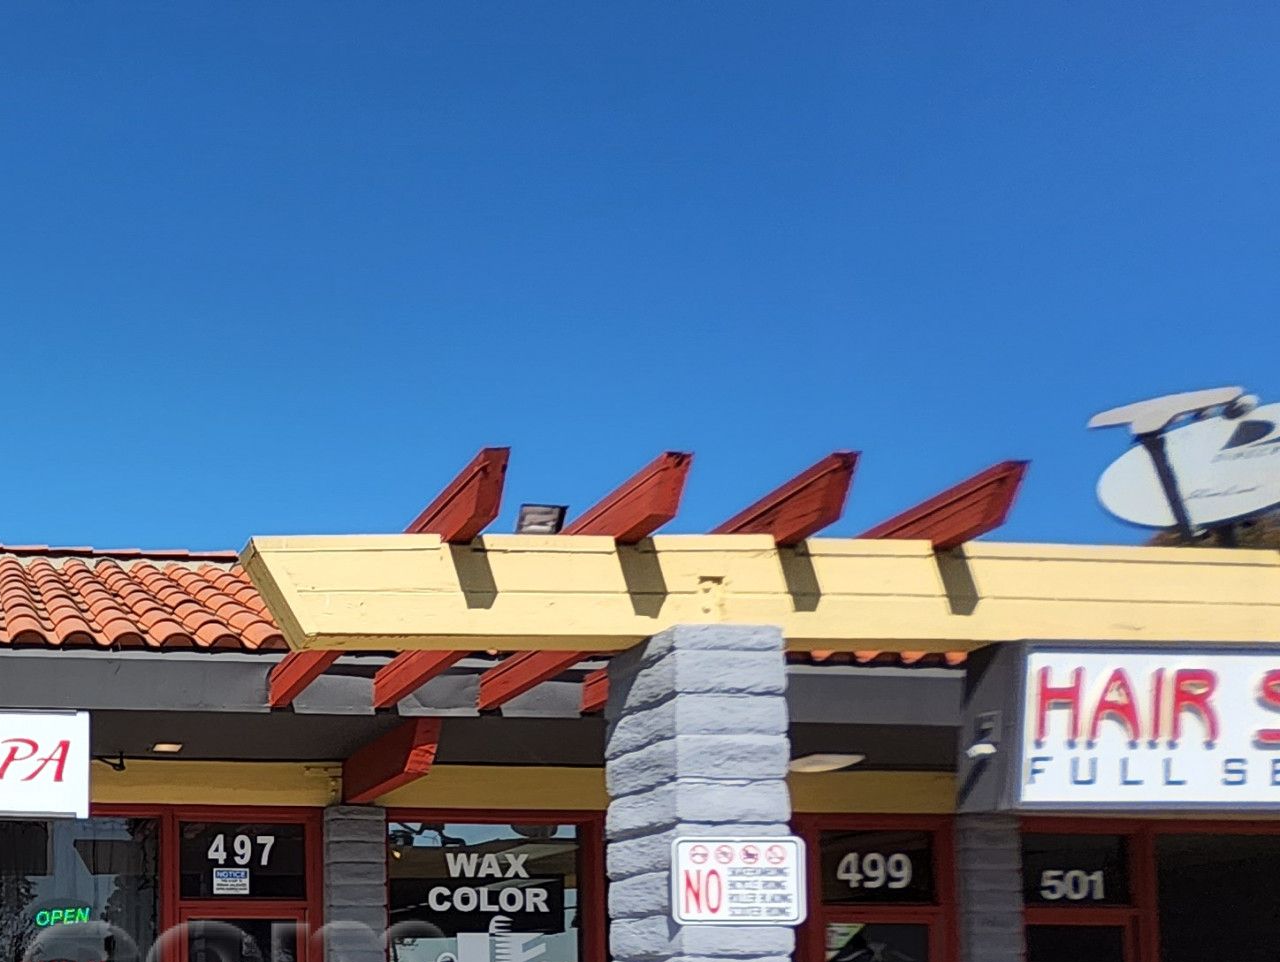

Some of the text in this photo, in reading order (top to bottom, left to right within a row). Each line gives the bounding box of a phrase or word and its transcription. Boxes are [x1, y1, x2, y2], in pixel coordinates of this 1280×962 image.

[1035, 666, 1219, 744] HAIR
[1027, 757, 1186, 786] FULL
[208, 834, 274, 866] 497
[446, 853, 529, 878] WAX
[836, 852, 913, 889] 499
[428, 887, 550, 912] COLOR
[684, 869, 722, 913] NO
[1040, 870, 1105, 900] 501
[36, 907, 90, 926] OPEN
